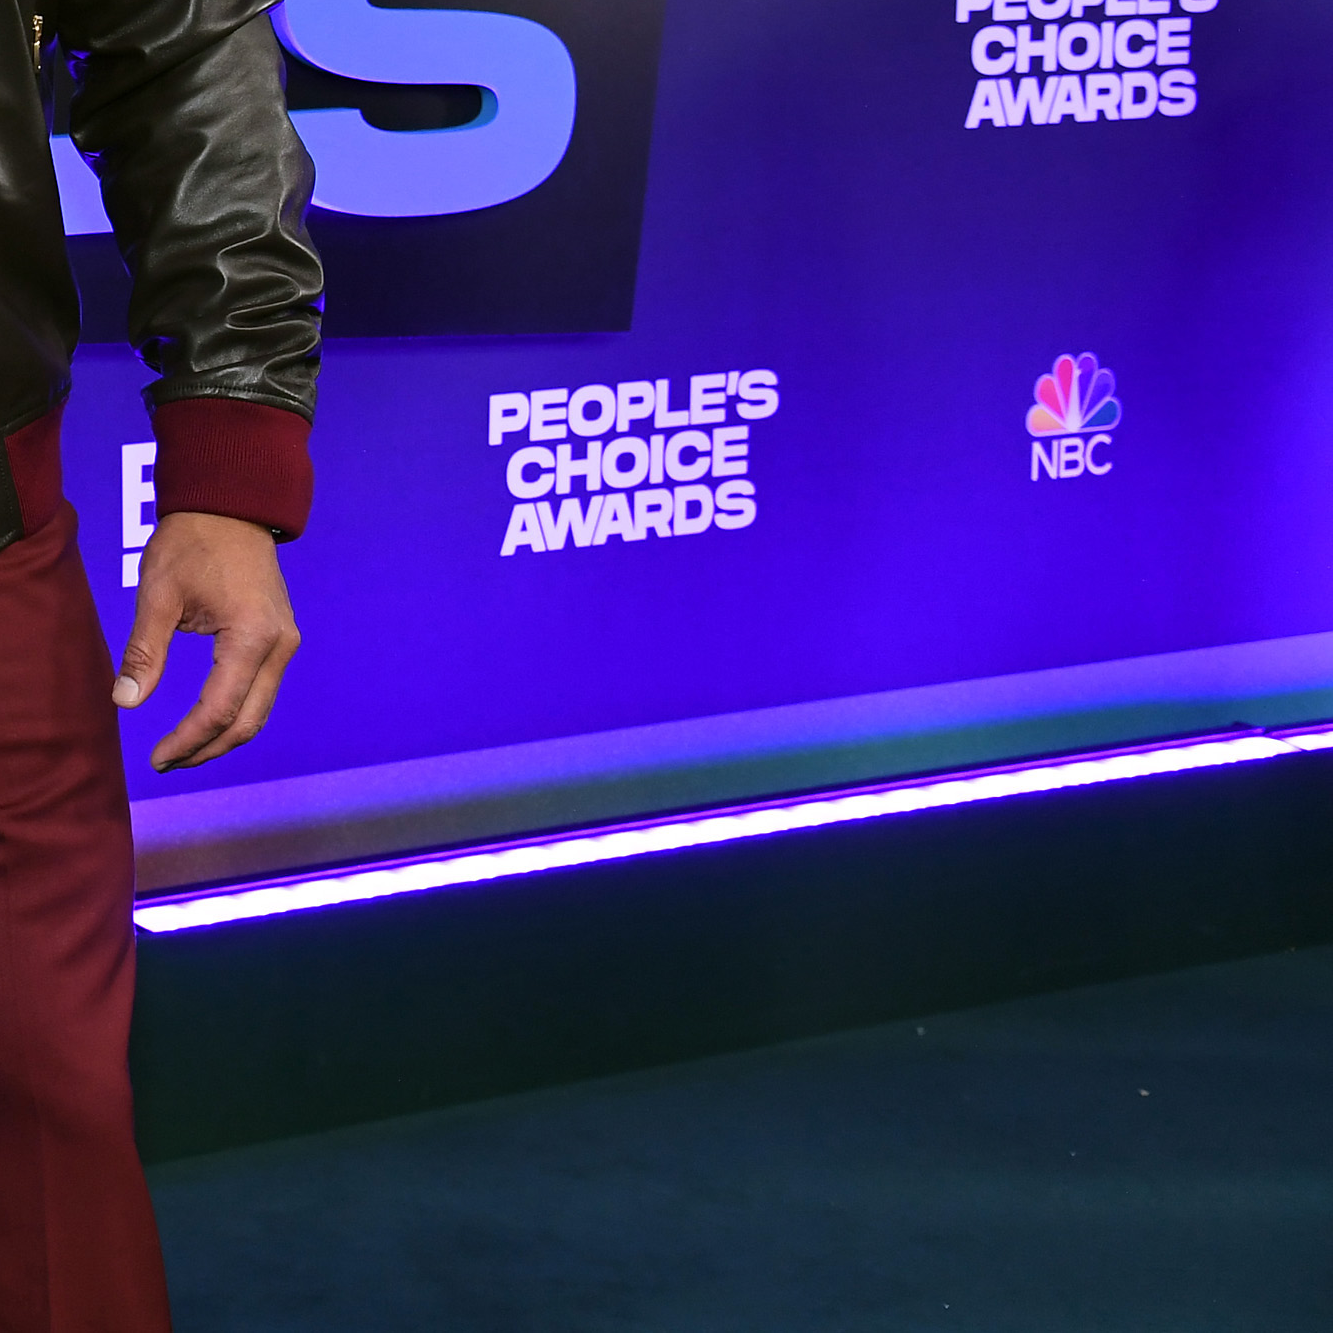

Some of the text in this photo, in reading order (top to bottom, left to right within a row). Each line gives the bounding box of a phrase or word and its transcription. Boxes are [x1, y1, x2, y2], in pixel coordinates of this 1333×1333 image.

[971, 18, 1191, 76] CHOICE
[964, 69, 1196, 129] AWARDS
[488, 369, 779, 446] PEOPLE'S
[506, 425, 749, 499] CHOICE
[1031, 433, 1112, 482] NBC
[500, 479, 756, 557] AWARDS
